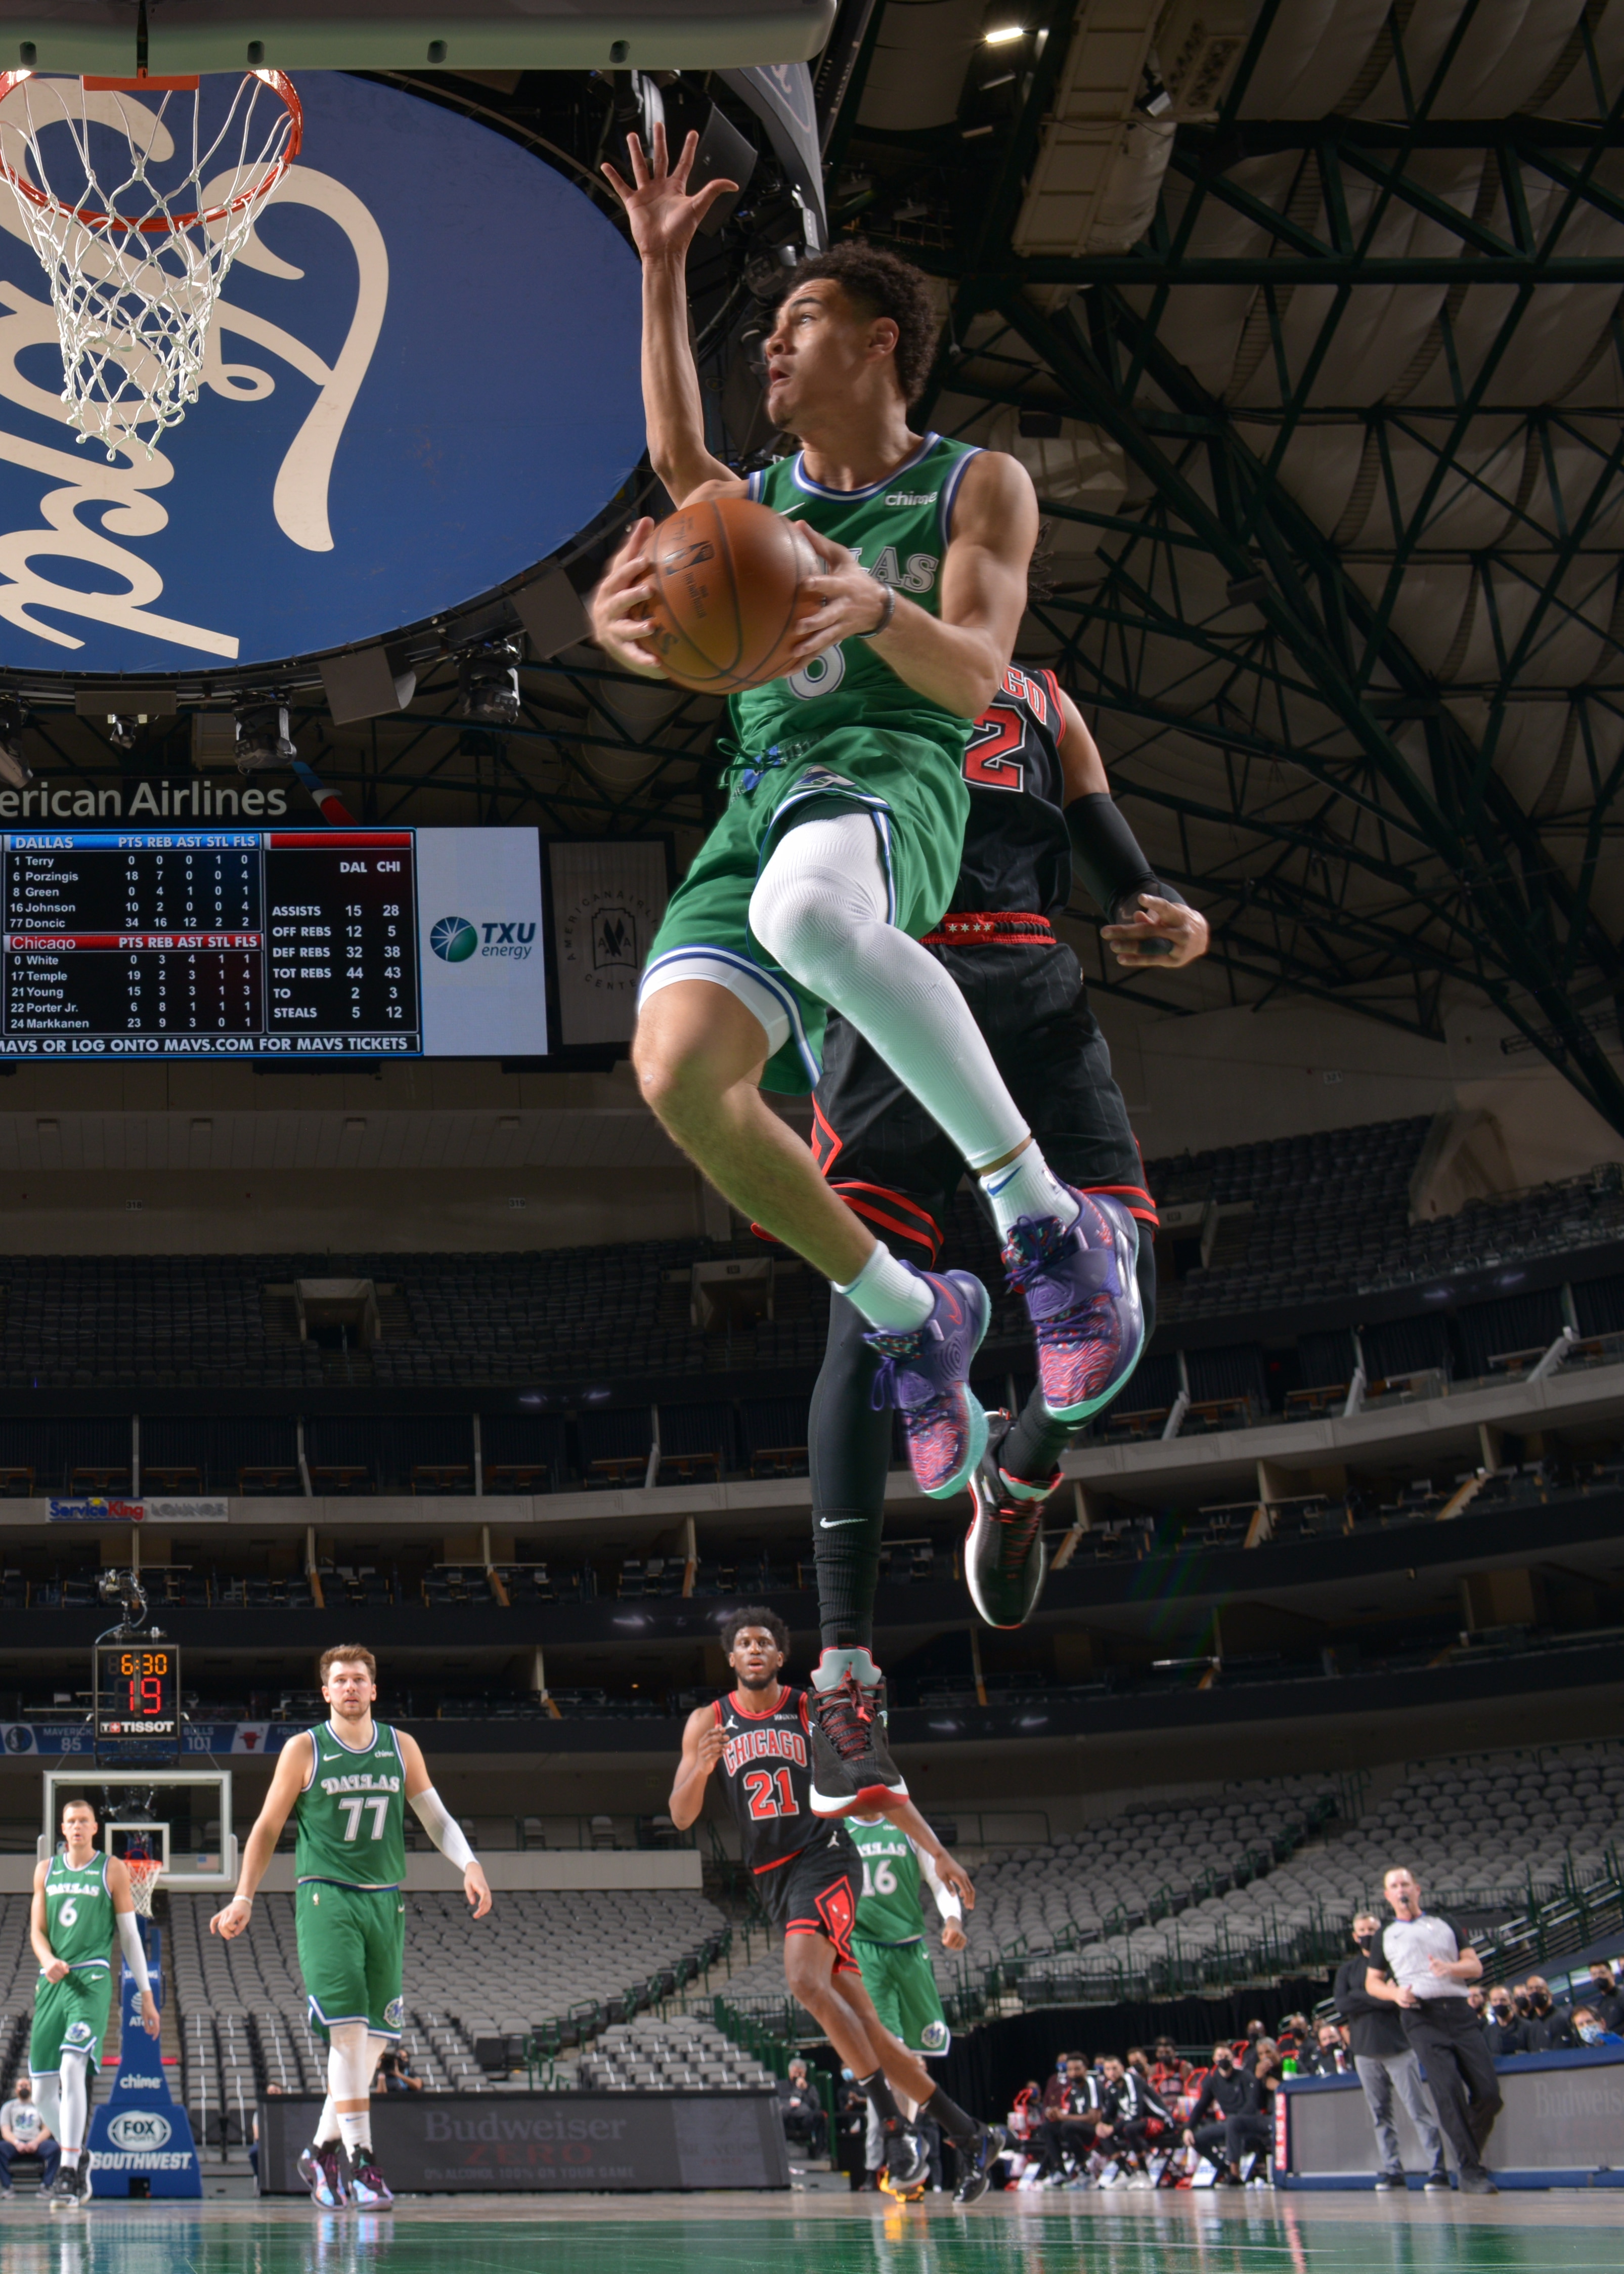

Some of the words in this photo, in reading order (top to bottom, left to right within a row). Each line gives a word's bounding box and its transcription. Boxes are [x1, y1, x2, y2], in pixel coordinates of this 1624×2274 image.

[885, 491, 938, 506] chime
[128, 781, 288, 818] Airlines
[16, 837, 73, 848] DALLAS
[119, 837, 142, 847] PTS
[148, 837, 172, 847] REB
[177, 836, 201, 847] AST
[207, 836, 228, 846] STL
[234, 836, 255, 846] FLS
[15, 857, 19, 865] 1
[26, 856, 54, 867] Terry
[128, 856, 135, 865] 0
[157, 856, 162, 865] 0
[186, 855, 192, 864] 0
[216, 855, 221, 864] 1
[241, 855, 247, 864] 0
[340, 862, 367, 872] DAL
[377, 862, 400, 872] CHI
[13, 872, 20, 881] 6
[26, 872, 78, 883] Porzingis
[126, 872, 138, 880] 18
[157, 871, 163, 880] 7
[186, 871, 192, 880] 0
[215, 871, 221, 879] 0
[241, 871, 248, 879] 4
[13, 888, 19, 896] 8
[26, 887, 59, 896] Green
[128, 887, 135, 895] 0
[157, 887, 163, 895] 4
[188, 886, 192, 895] 1
[215, 886, 221, 895] 0
[243, 886, 247, 894] 1
[11, 904, 23, 912] 16
[25, 903, 75, 912] Johnson
[126, 903, 138, 911] 10
[157, 903, 163, 911] 2
[187, 902, 193, 911] 0
[215, 902, 222, 911] 0
[242, 902, 248, 910] 4
[272, 907, 321, 916] ASSISTS
[346, 906, 362, 916] 15
[383, 905, 399, 916] 28
[10, 919, 23, 927] 77
[26, 919, 65, 927] Doncic
[126, 918, 138, 927] 34
[154, 918, 166, 927] 16
[184, 918, 196, 926] 12
[216, 917, 222, 926] 2
[243, 917, 248, 926] 2
[273, 927, 296, 936] OFF
[301, 927, 331, 936] REBS
[346, 926, 362, 937] 12
[388, 926, 396, 936] 5
[480, 922, 536, 944] TXU
[119, 937, 143, 948] PTS
[148, 937, 173, 948] REB
[178, 937, 203, 947] AST
[208, 936, 230, 947] STL
[235, 936, 257, 947] FLS
[273, 948, 295, 957] DEF
[300, 948, 330, 957] REBS
[347, 947, 362, 958] 32
[385, 947, 400, 957] 38
[481, 945, 532, 961] energy
[15, 956, 21, 965] 0
[27, 956, 58, 965] White
[130, 955, 137, 964] 0
[159, 955, 165, 964] 3
[189, 955, 195, 963] 4
[219, 955, 224, 963] 1
[244, 954, 249, 963] 1
[12, 972, 24, 980] 17
[27, 971, 67, 982] Temple
[128, 971, 140, 980] 19
[159, 971, 165, 979] 2
[189, 970, 195, 979] 3
[220, 970, 224, 979] 1
[243, 970, 250, 978] 4
[273, 969, 296, 978] TOT
[301, 968, 331, 978] REBS
[347, 967, 363, 978] 44
[384, 967, 401, 978] 43
[12, 988, 23, 996] 21
[27, 988, 63, 999] Young
[128, 987, 141, 996] 15
[159, 986, 165, 996] 3
[190, 986, 195, 995] 3
[220, 986, 224, 995] 1
[244, 986, 250, 995] 3
[274, 989, 290, 998] TO
[352, 988, 359, 999] 2
[390, 987, 397, 998] 3
[11, 1003, 24, 1012] 22
[27, 1003, 62, 1012] Porter
[65, 1003, 78, 1012] Jr.
[131, 1003, 137, 1011] 6
[159, 1002, 165, 1011] 8
[191, 1002, 195, 1011] 1
[220, 1002, 224, 1010] 1
[245, 1002, 249, 1010] 1
[274, 1008, 317, 1017] STEALS
[353, 1007, 360, 1018] 5
[386, 1007, 402, 1017] 12
[11, 1019, 24, 1028] 24
[27, 1019, 89, 1028] Markkanen
[128, 1018, 141, 1027] 23
[159, 1018, 165, 1027] 9
[190, 1018, 196, 1027] 3
[218, 1018, 225, 1026] 0
[245, 1017, 250, 1026] 1
[43, 1040, 66, 1052] OR
[72, 1040, 105, 1052] LOG
[111, 1040, 158, 1051] ONTO
[164, 1039, 253, 1051] MAVS.COM
[260, 1039, 290, 1050] FOR
[297, 1038, 343, 1050] MAVS
[348, 1038, 407, 1050] TICKETS
[151, 1503, 225, 1516] LOUNGE
[121, 1654, 167, 1675] 6:30
[130, 1678, 160, 1713] 19
[43, 1726, 94, 1735] MAVERICK
[183, 1726, 214, 1735] BULLS
[121, 1722, 174, 1732] TISSOT
[61, 1736, 81, 1750] 85
[187, 1736, 211, 1749] 101
[374, 1749, 394, 1758] chime
[723, 1728, 807, 1777] CHICAGO
[321, 1774, 400, 1795] DALLAS
[743, 1766, 800, 1821] 21
[338, 1796, 389, 1841] 77
[861, 1859, 898, 1897] 16
[46, 1883, 100, 1897] DALLAS
[58, 1898, 78, 1927] 6
[120, 2074, 160, 2089] chime
[123, 2120, 155, 2134] FOX
[423, 2111, 628, 2142] Budweiser
[464, 2143, 593, 2165] ZERO
[93, 2152, 192, 2170] SOUTHWEST
